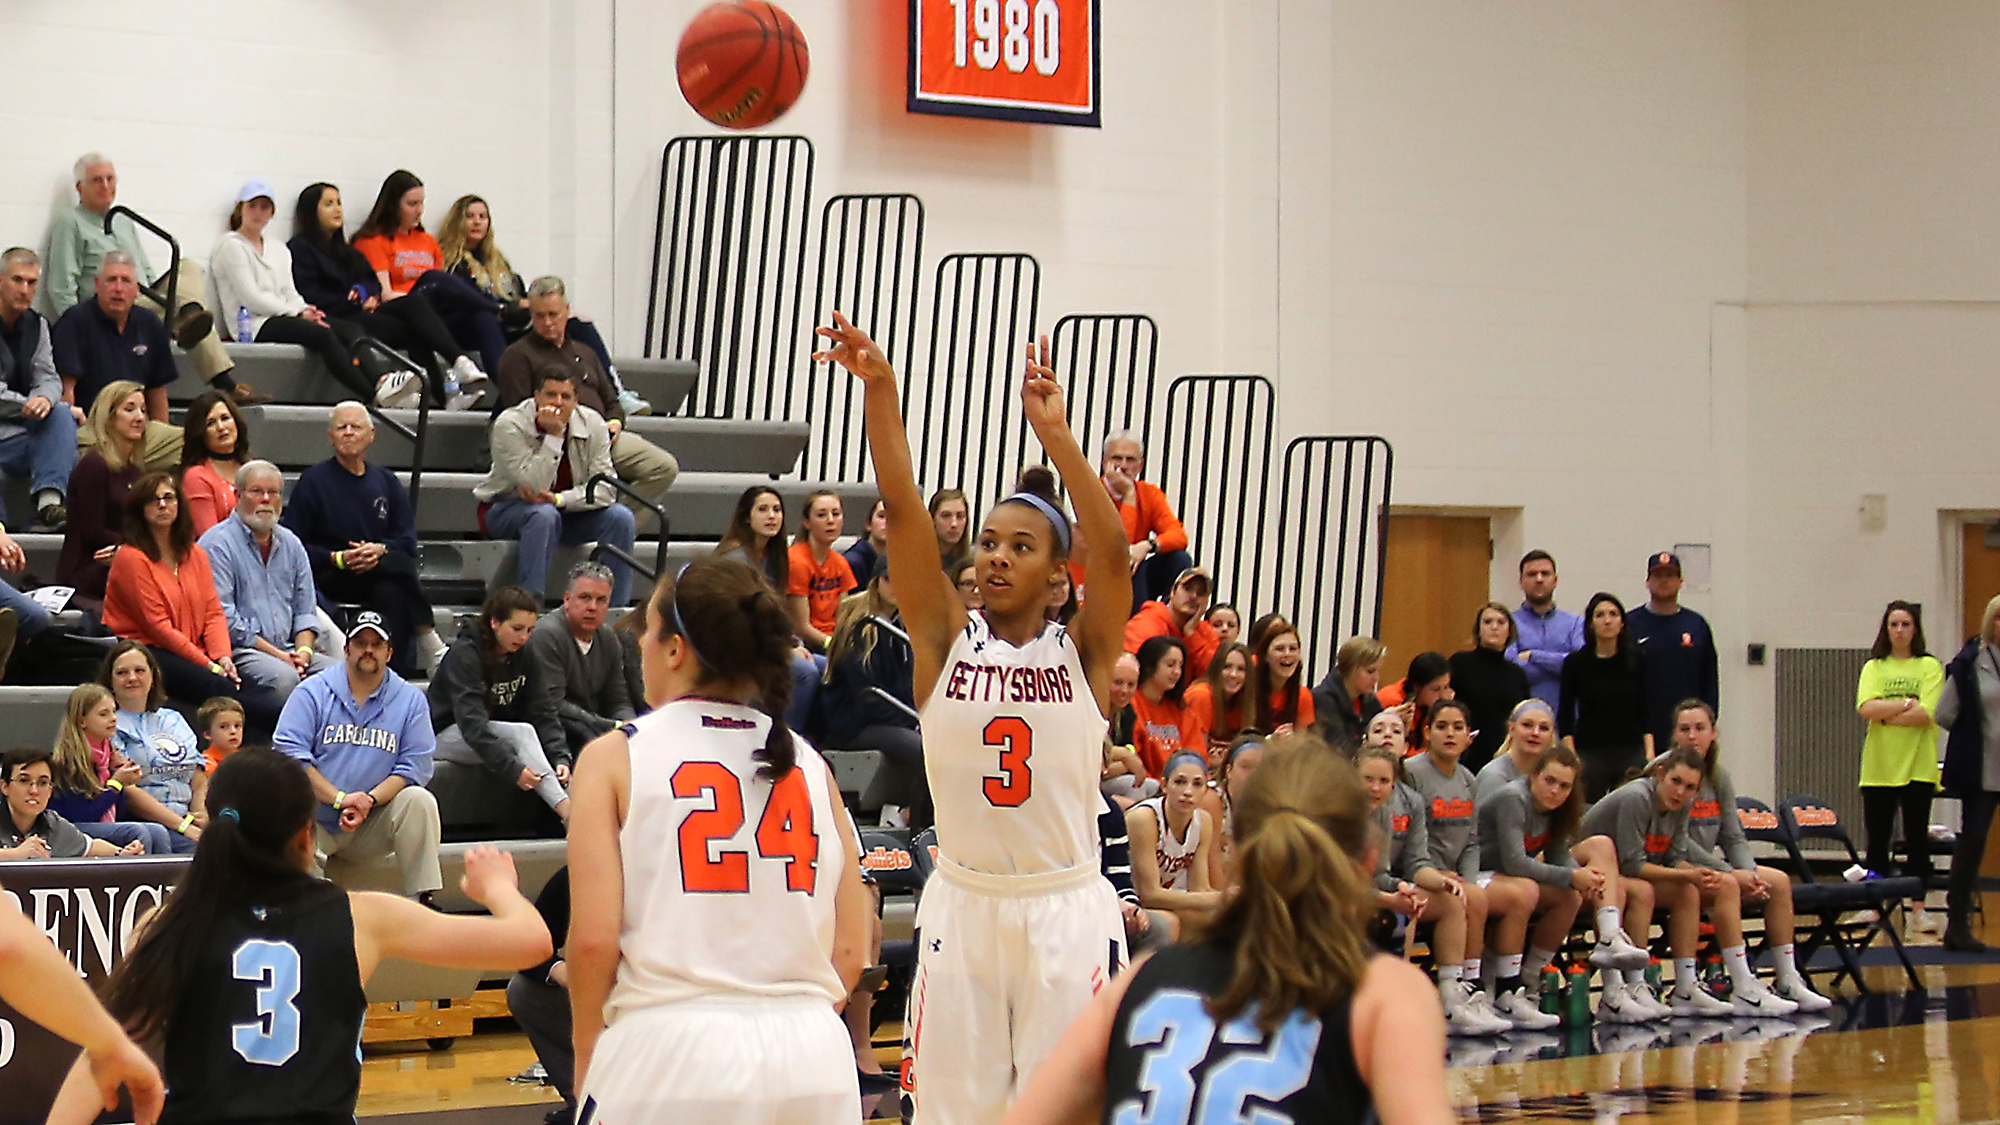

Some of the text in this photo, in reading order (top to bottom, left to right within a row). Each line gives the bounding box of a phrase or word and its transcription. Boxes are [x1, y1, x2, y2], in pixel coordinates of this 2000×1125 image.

[949, 0, 1061, 76] 1980
[945, 660, 1074, 703] GETTYSBURG
[322, 722, 397, 754] CAROLINA
[982, 715, 1034, 808] 3
[669, 760, 820, 898] 24
[861, 846, 912, 870] ullets
[232, 939, 301, 1067] 3
[1112, 988, 1324, 1125] 32
